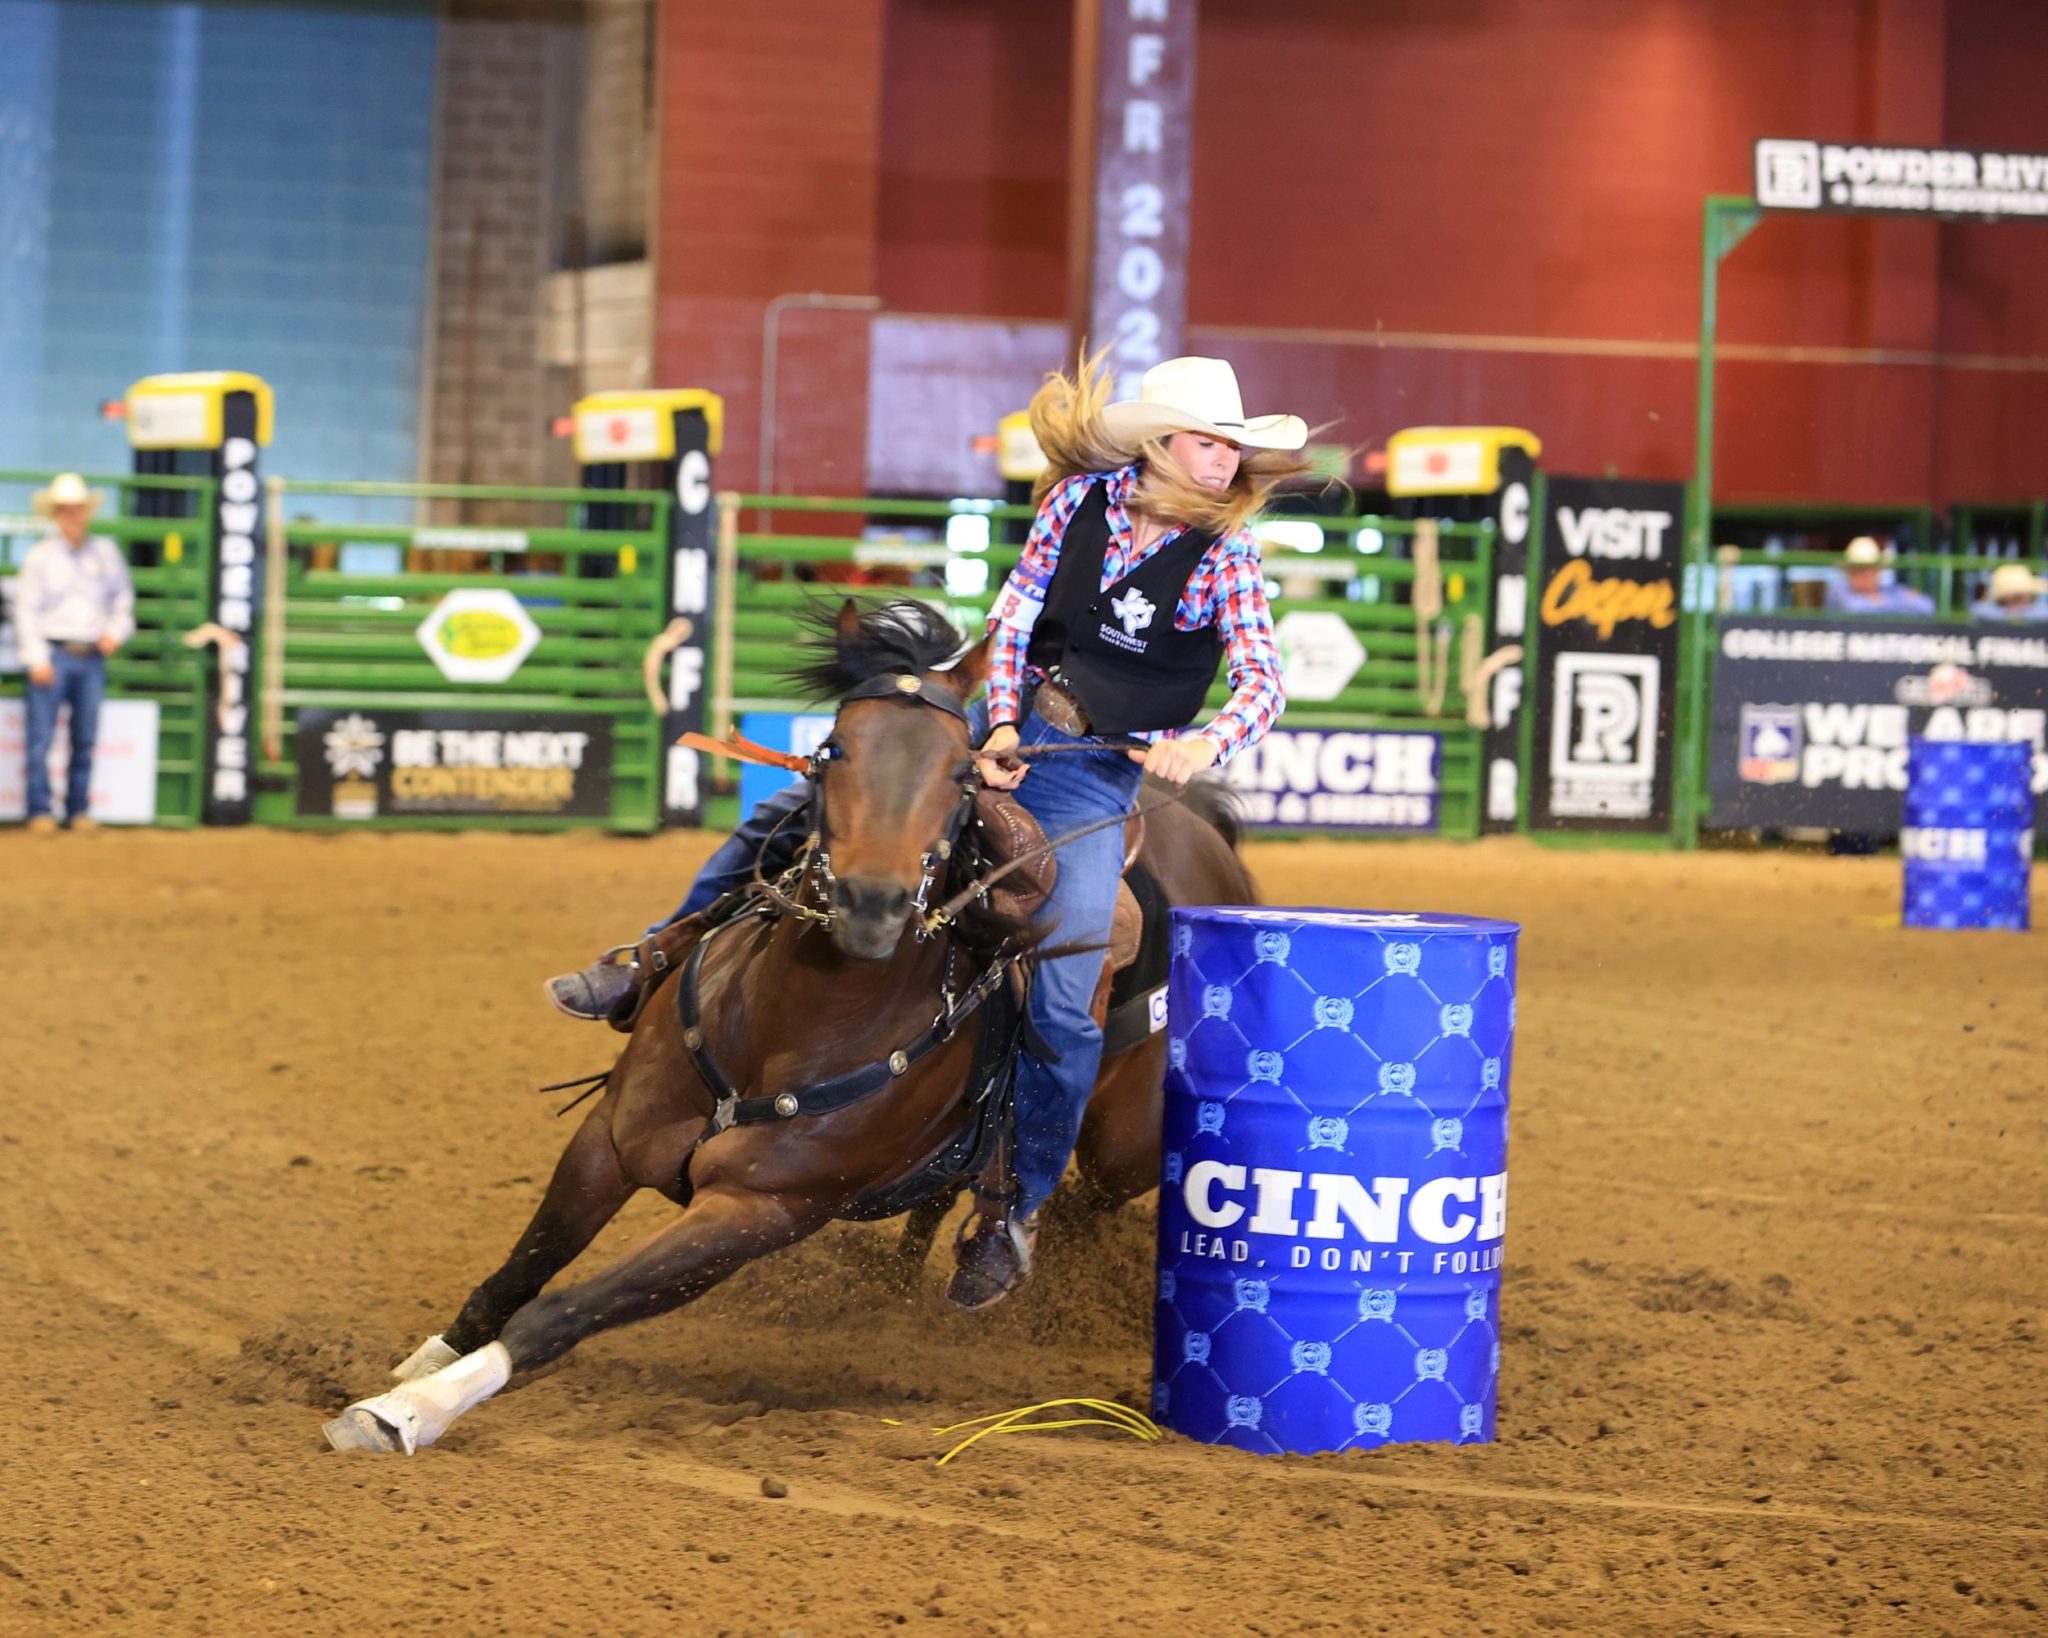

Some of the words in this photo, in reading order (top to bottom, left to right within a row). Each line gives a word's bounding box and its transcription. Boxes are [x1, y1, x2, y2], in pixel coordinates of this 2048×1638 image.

[1821, 145, 1977, 187] POWDER
[218, 437, 258, 630] POWDER
[1556, 506, 1672, 560] VISIT
[666, 450, 709, 811] CNFR
[1100, 623, 1148, 649] SOUTHWEST
[1722, 628, 1844, 661] COLLEGE
[1847, 632, 1974, 665] NATIONAL
[392, 730, 437, 766] BE
[440, 730, 500, 767] THE
[503, 731, 588, 769] NEXT
[1804, 702, 1909, 747] WE
[1923, 706, 2045, 752] ARE
[1222, 731, 1439, 794] INCH
[1182, 1160, 1507, 1245] CINCH
[1180, 1230, 1265, 1268] LEAD,
[1290, 1244, 1414, 1273] DON'T
[1432, 1245, 1504, 1275] FOLLO
